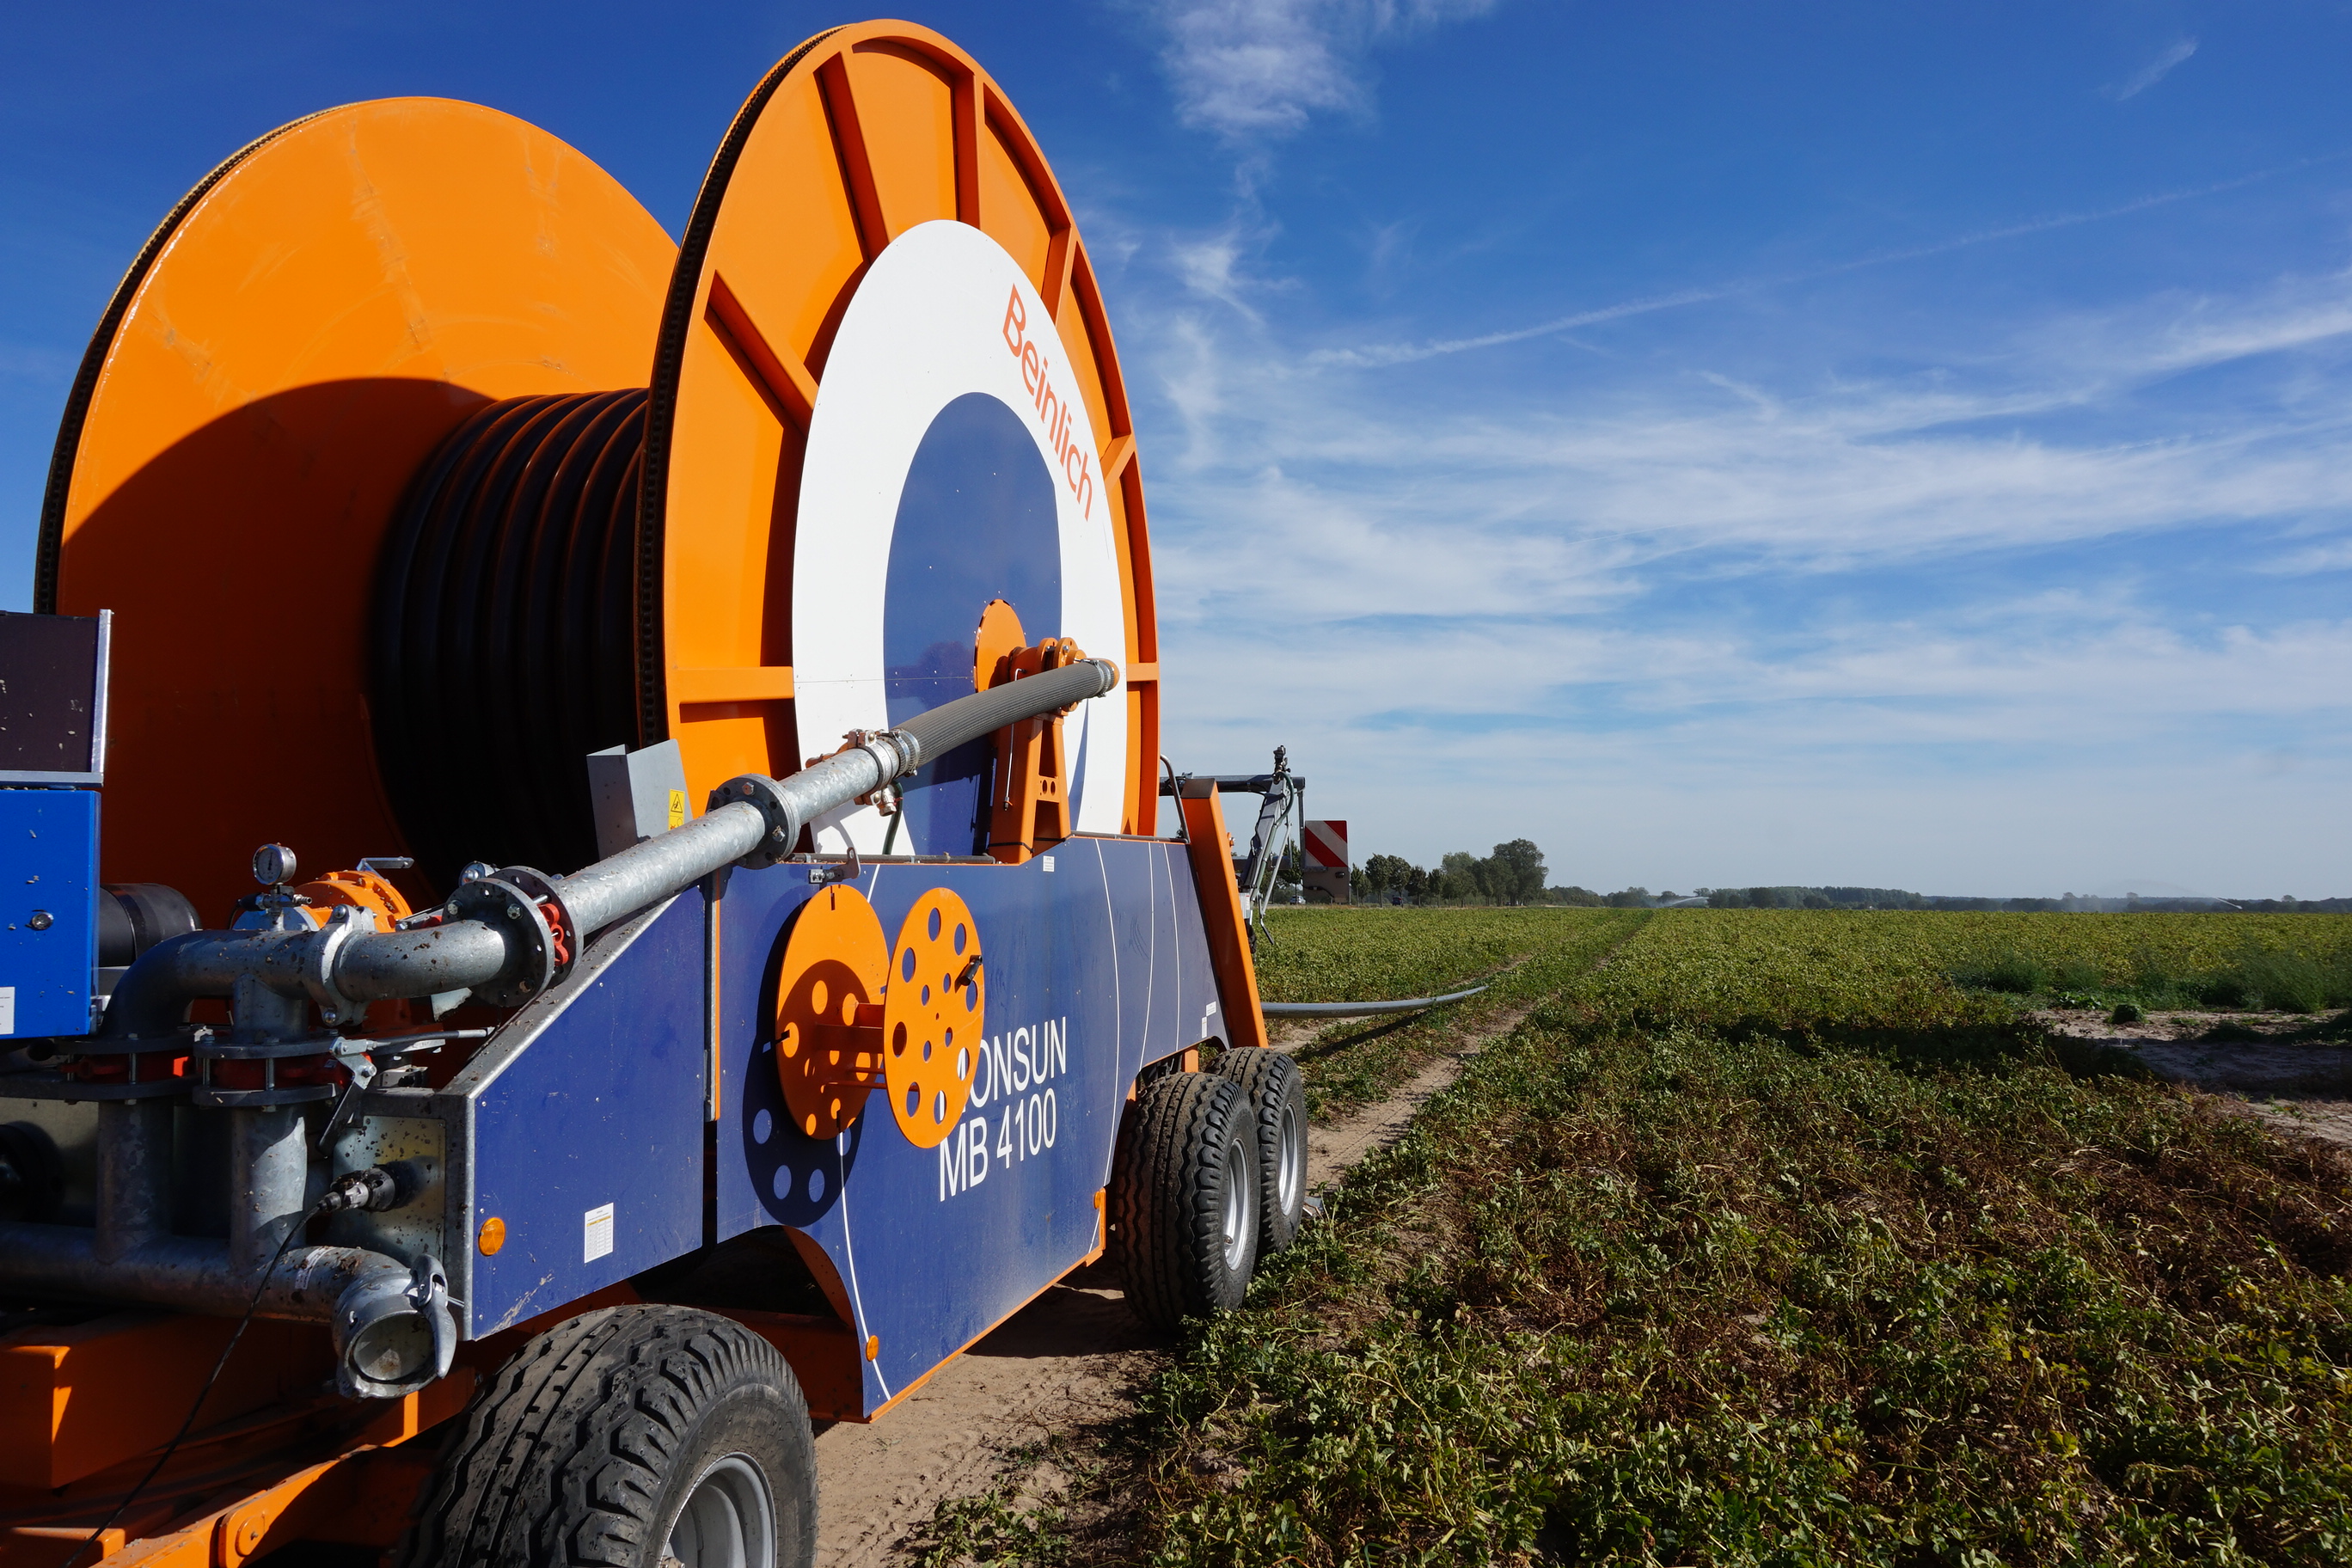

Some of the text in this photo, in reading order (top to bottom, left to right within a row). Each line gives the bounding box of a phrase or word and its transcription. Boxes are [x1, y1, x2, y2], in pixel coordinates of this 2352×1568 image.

[1002, 283, 1093, 523] Beinlich
[939, 1016, 1066, 1121] ONSUN
[940, 1087, 1057, 1202] MB 4100
